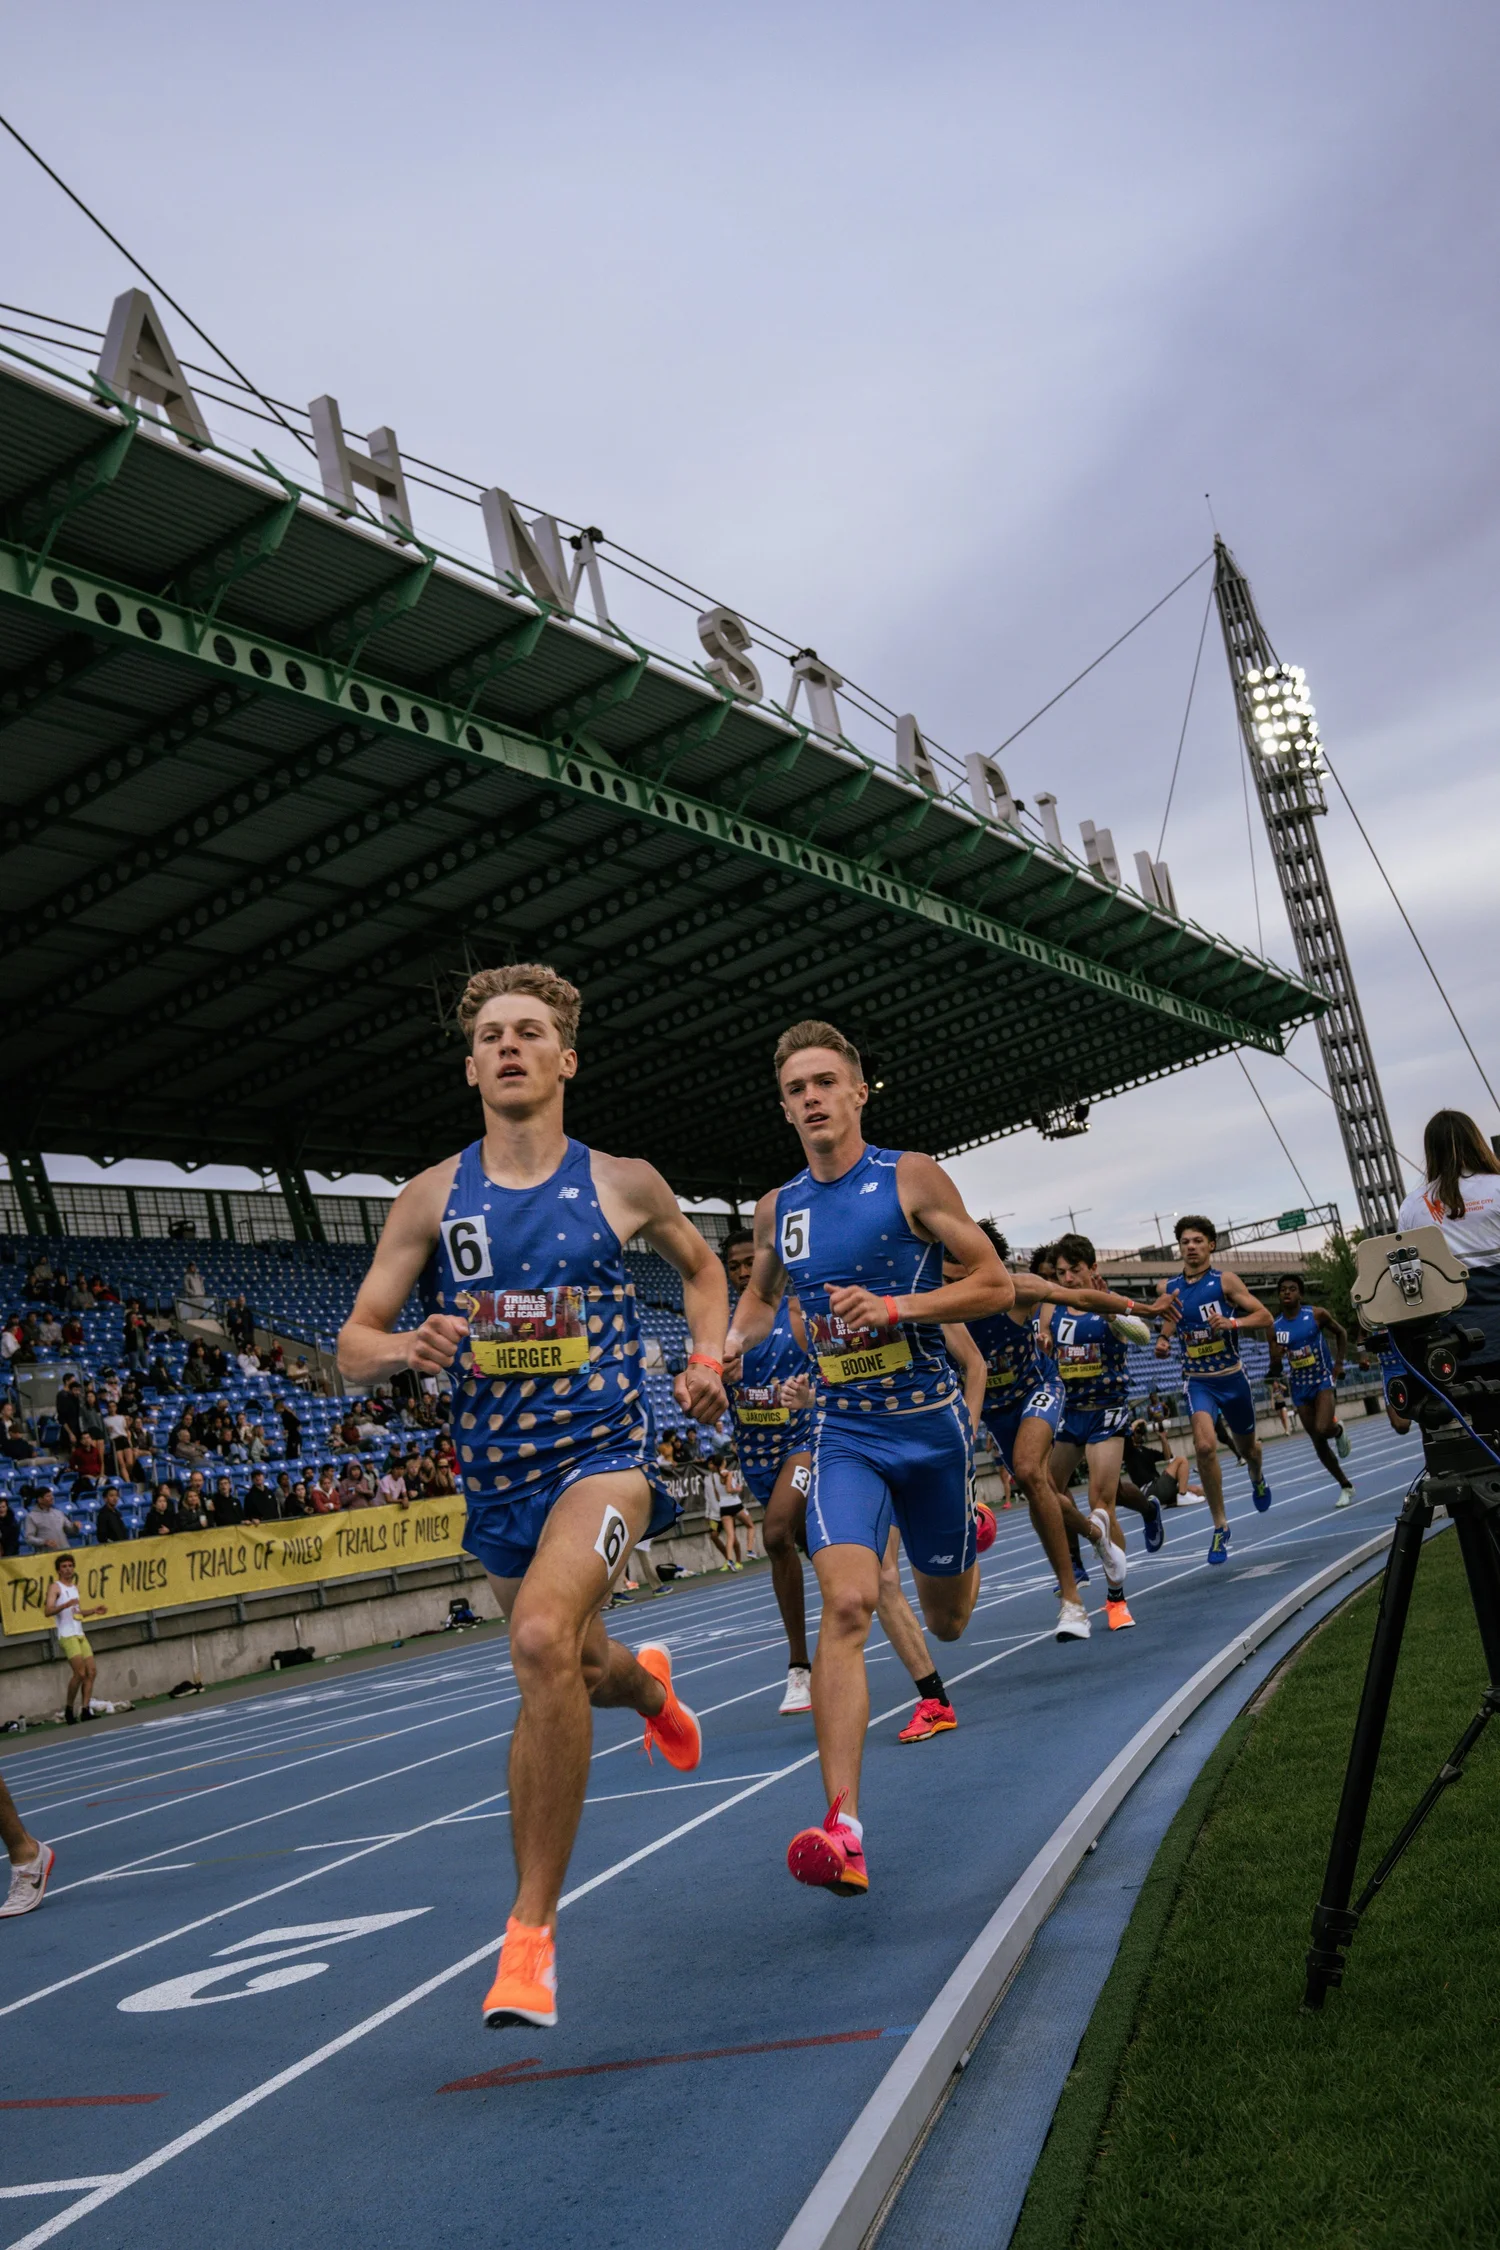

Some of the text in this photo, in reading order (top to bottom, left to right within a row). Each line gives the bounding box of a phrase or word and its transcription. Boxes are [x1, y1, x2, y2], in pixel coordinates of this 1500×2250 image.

[1464, 1205, 1484, 1213] ATHON
[784, 1213, 804, 1258] 5
[449, 1221, 483, 1276] 6
[503, 1295, 547, 1304] TRIALS
[518, 1303, 546, 1311] MILES
[1201, 1303, 1216, 1318] 11
[1062, 1320, 1074, 1341] 7
[1277, 1332, 1287, 1343] 10
[496, 1346, 562, 1368] HERGER
[841, 1353, 886, 1376] BOONE
[1031, 1394, 1050, 1408] 8
[746, 1412, 781, 1422] JAKOVICS
[1107, 1410, 1120, 1428] 7
[796, 1468, 810, 1491] 3
[603, 1515, 625, 1567] 6
[8, 1515, 450, 1612] TRI OF MILES TRIALS OF MILES TRIALS OF MILES
